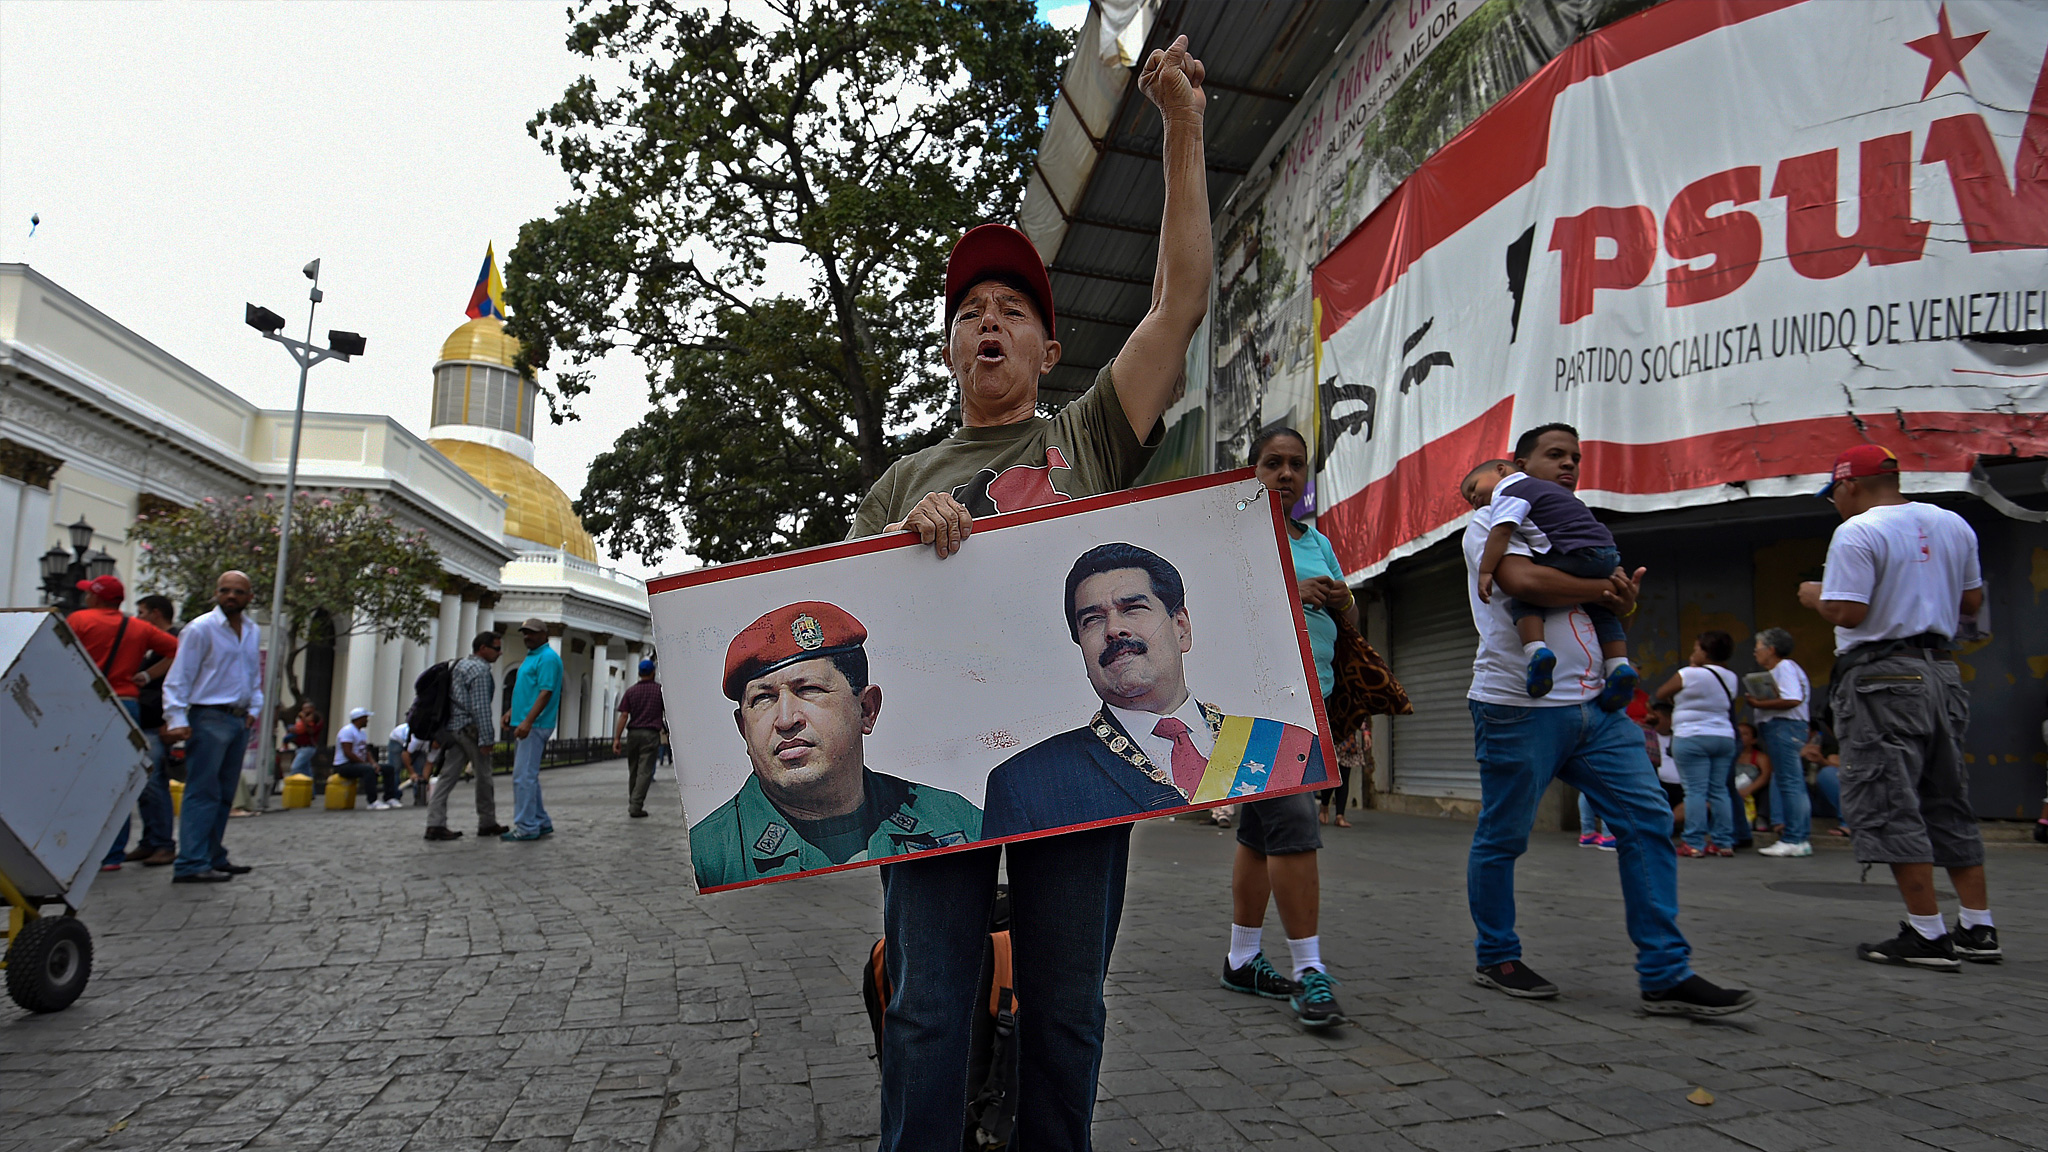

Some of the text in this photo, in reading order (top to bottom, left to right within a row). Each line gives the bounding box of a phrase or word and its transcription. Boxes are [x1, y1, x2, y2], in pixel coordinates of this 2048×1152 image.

[1326, 103, 1367, 161] BUENO
[1403, 1, 1457, 73] MEJOR
[1335, 11, 1396, 122] PARQUE
[1555, 346, 1633, 392] PARTIDO
[1640, 322, 1763, 385] SOCIALISTA
[1772, 308, 1857, 358] UNIDO
[1867, 303, 1900, 346] DE
